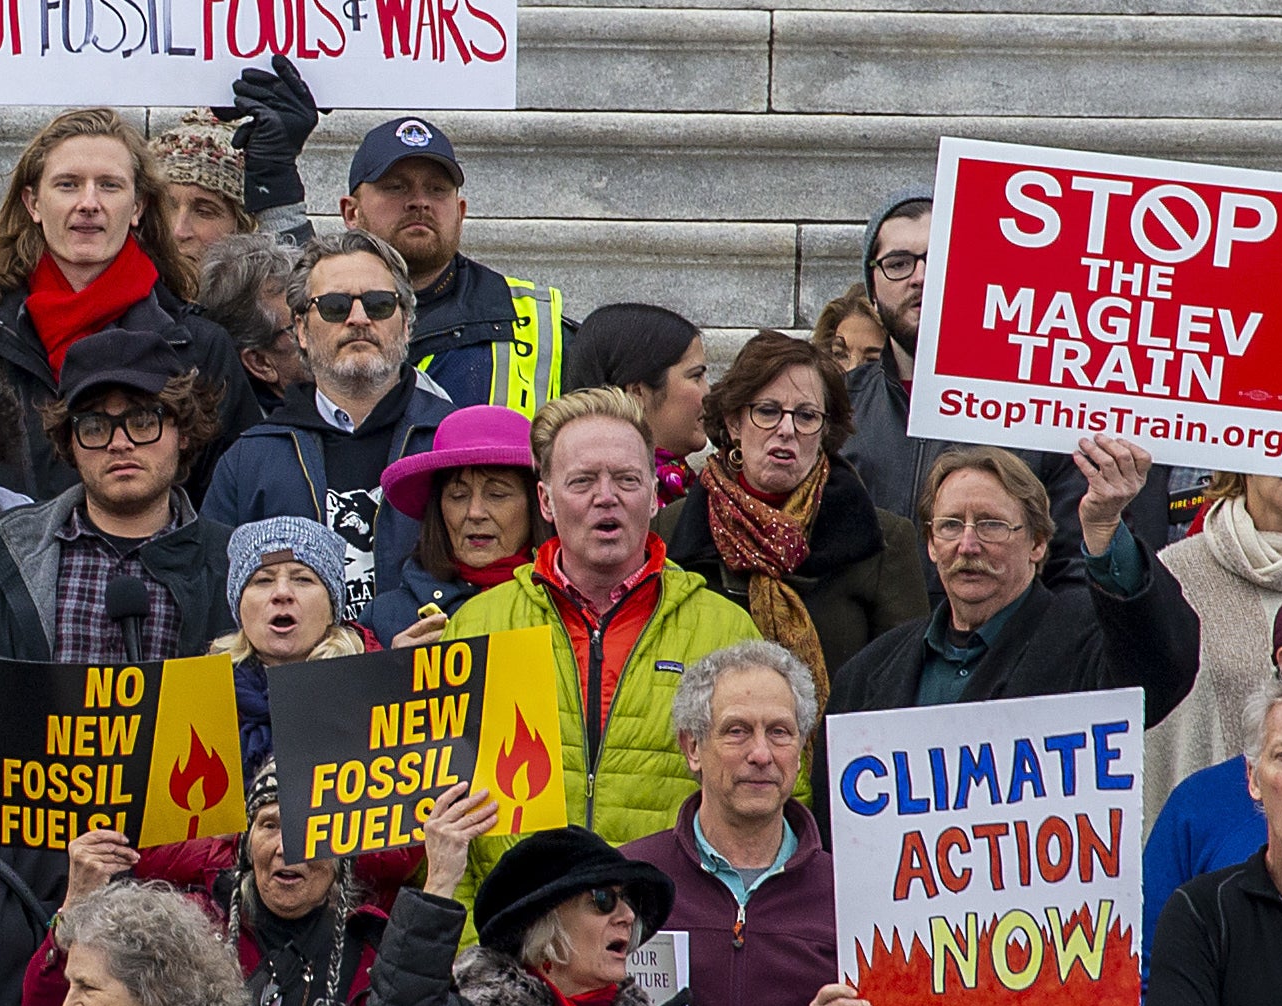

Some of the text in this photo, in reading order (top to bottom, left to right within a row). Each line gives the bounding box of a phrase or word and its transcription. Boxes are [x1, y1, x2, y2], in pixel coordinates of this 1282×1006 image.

[999, 170, 1278, 268] STOP
[1080, 257, 1176, 300] THE
[982, 283, 1264, 357] MAGLEV
[1008, 333, 1225, 402] TRAIN
[84, 666, 145, 709] NO
[412, 641, 473, 693] NO
[46, 714, 142, 757] NEW
[369, 692, 470, 750] NEW
[3, 758, 133, 806] FOSSIL
[310, 745, 459, 809] FOSSIL
[840, 719, 1134, 817] CLIMATE
[893, 808, 1123, 901] ACTION
[929, 899, 1114, 995] NOW
